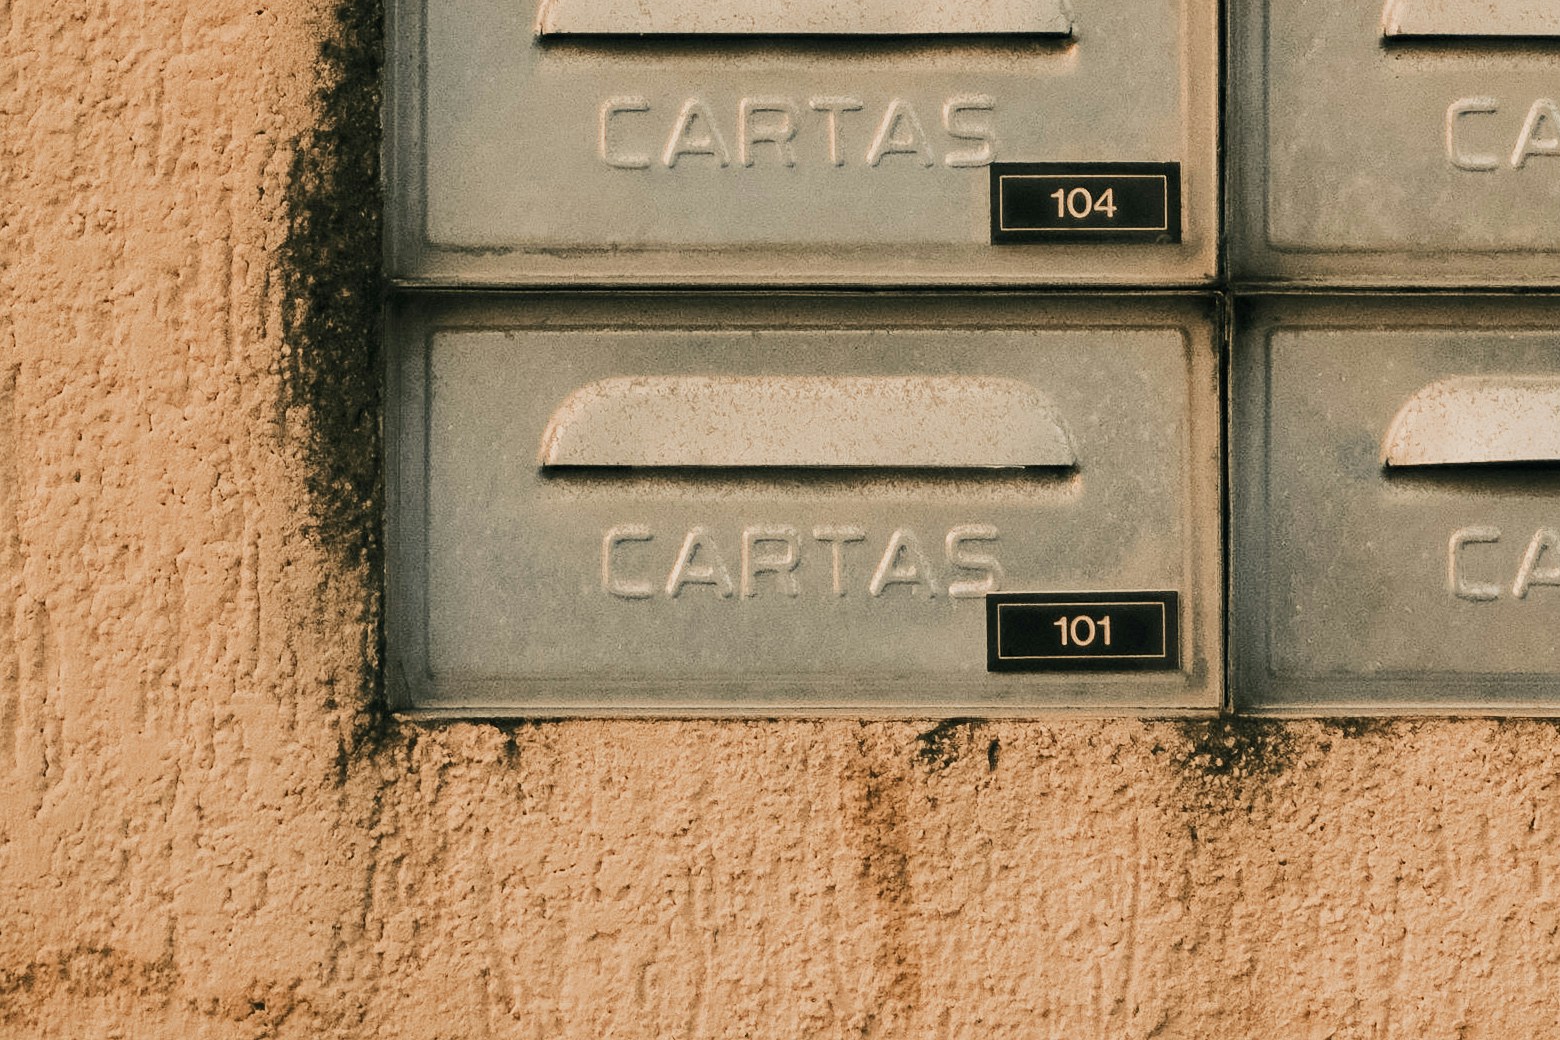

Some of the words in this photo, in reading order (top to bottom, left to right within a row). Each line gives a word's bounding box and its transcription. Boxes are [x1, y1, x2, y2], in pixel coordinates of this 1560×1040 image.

[599, 92, 998, 169] CARTAS
[1050, 187, 1118, 219] 104
[602, 523, 1001, 600] CARTAS
[1053, 615, 1111, 647] 101
